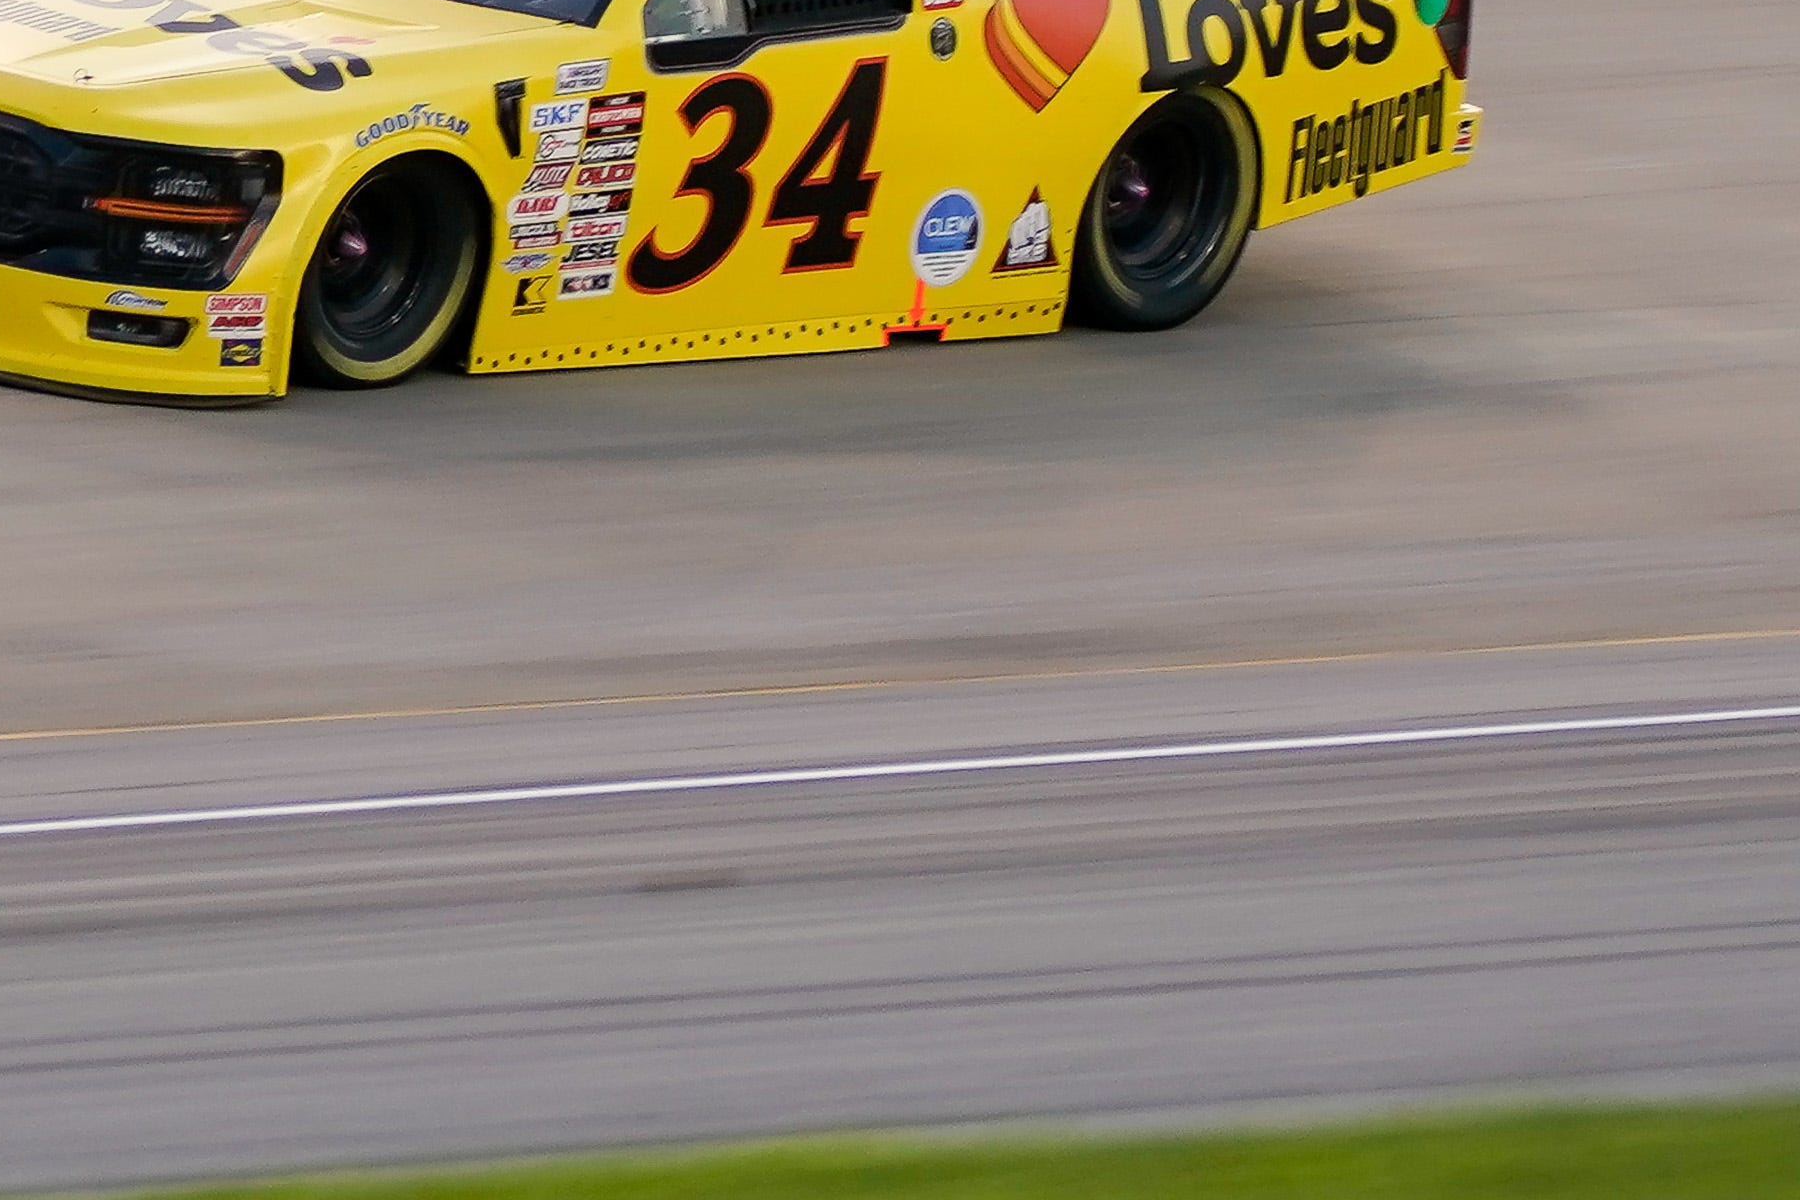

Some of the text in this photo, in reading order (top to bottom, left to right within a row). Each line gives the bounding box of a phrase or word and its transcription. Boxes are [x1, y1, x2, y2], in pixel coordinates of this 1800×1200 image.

[355, 102, 471, 148] GOODYEAR
[532, 102, 586, 128] SKF
[1282, 64, 1450, 199] Fleetguard
[625, 54, 891, 296] 34
